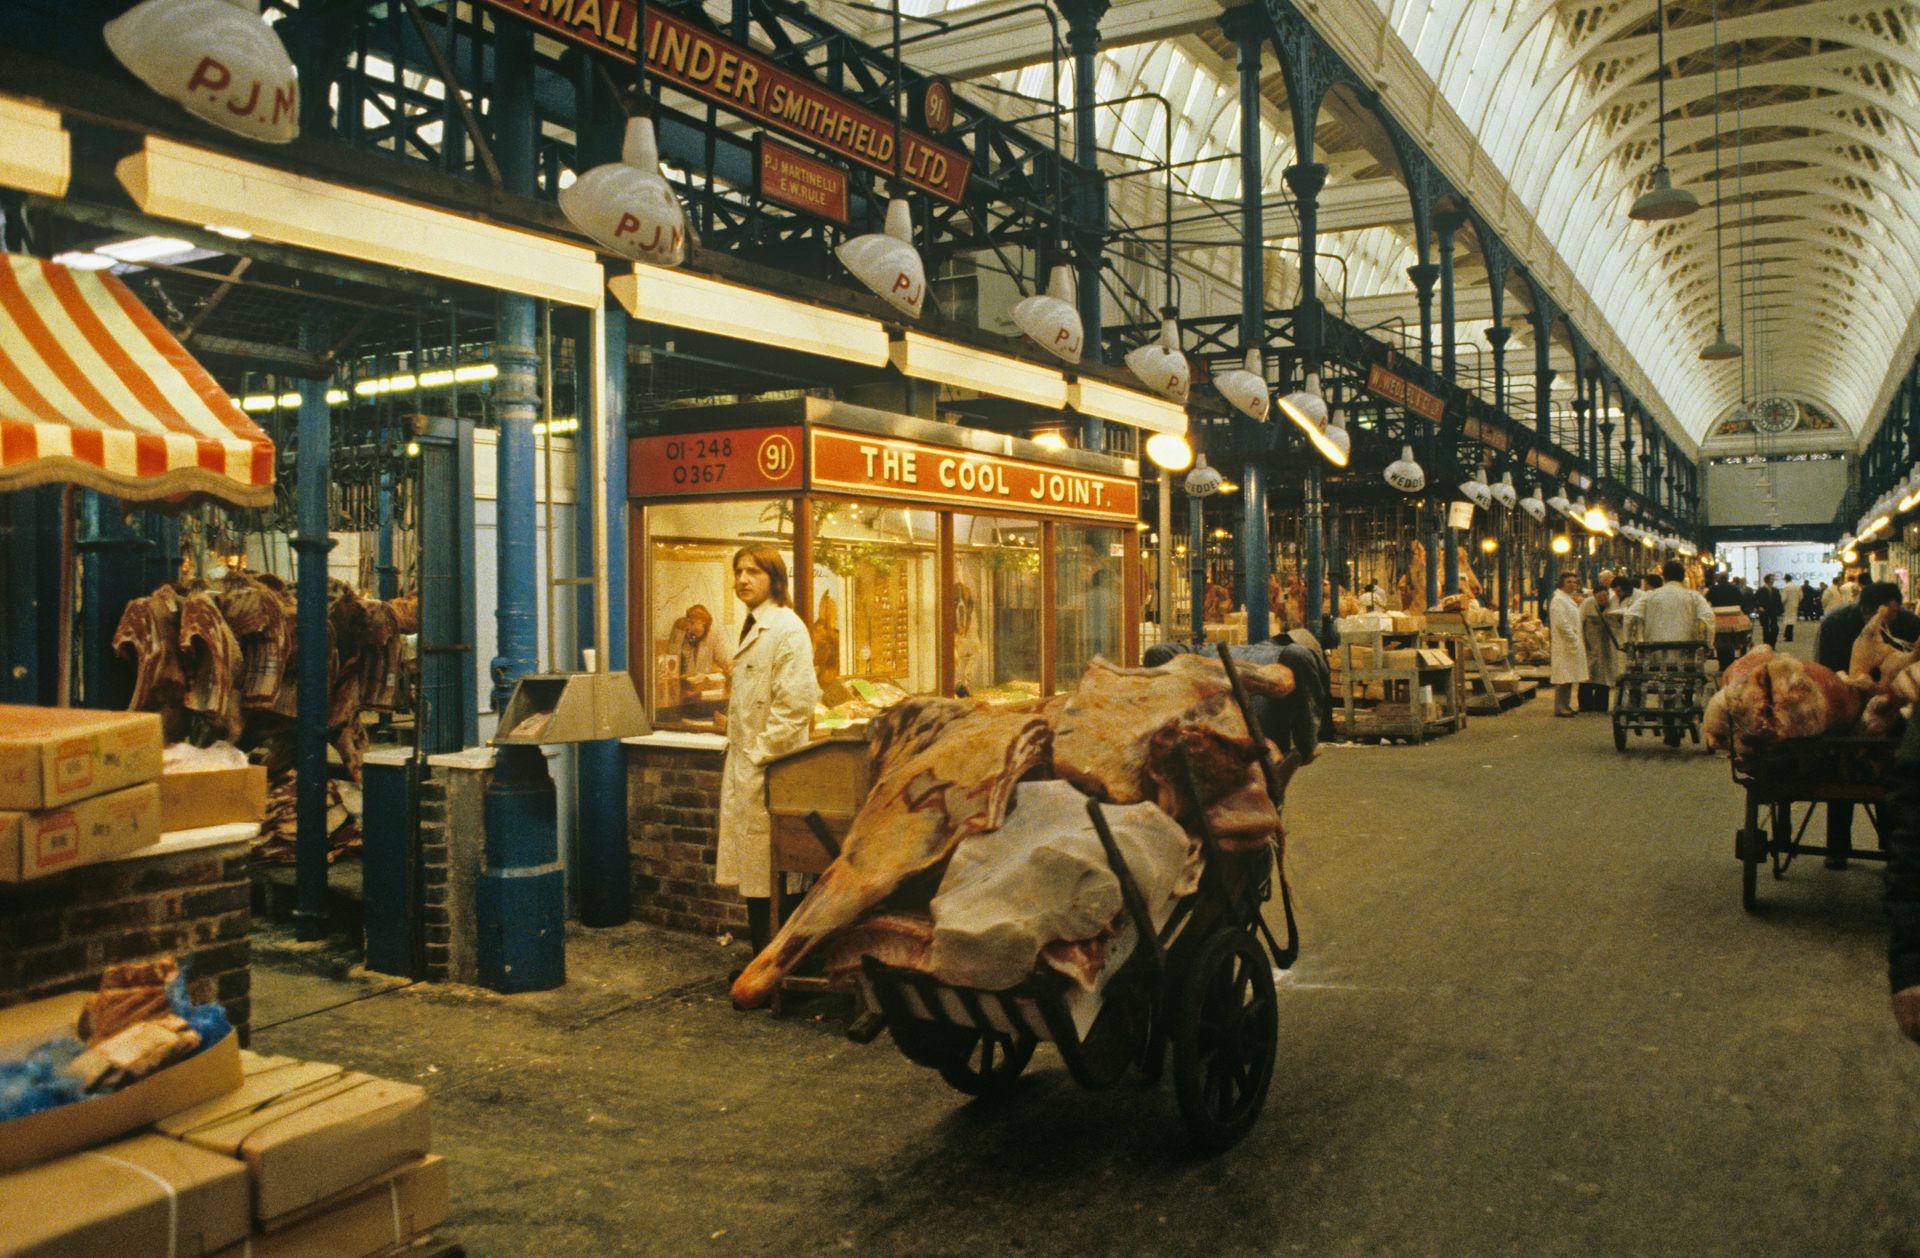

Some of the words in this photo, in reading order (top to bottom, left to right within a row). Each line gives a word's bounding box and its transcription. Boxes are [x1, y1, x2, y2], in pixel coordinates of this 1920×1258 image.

[929, 94, 942, 121] 91
[781, 161, 837, 192] MARTINELLI
[905, 141, 949, 190] LTD.
[665, 438, 733, 460] 01-248
[766, 444, 787, 471] 91
[673, 464, 726, 484] 0367
[860, 445, 917, 484] THE
[939, 458, 1009, 495] COOL
[1030, 473, 1111, 507] JOINT.
